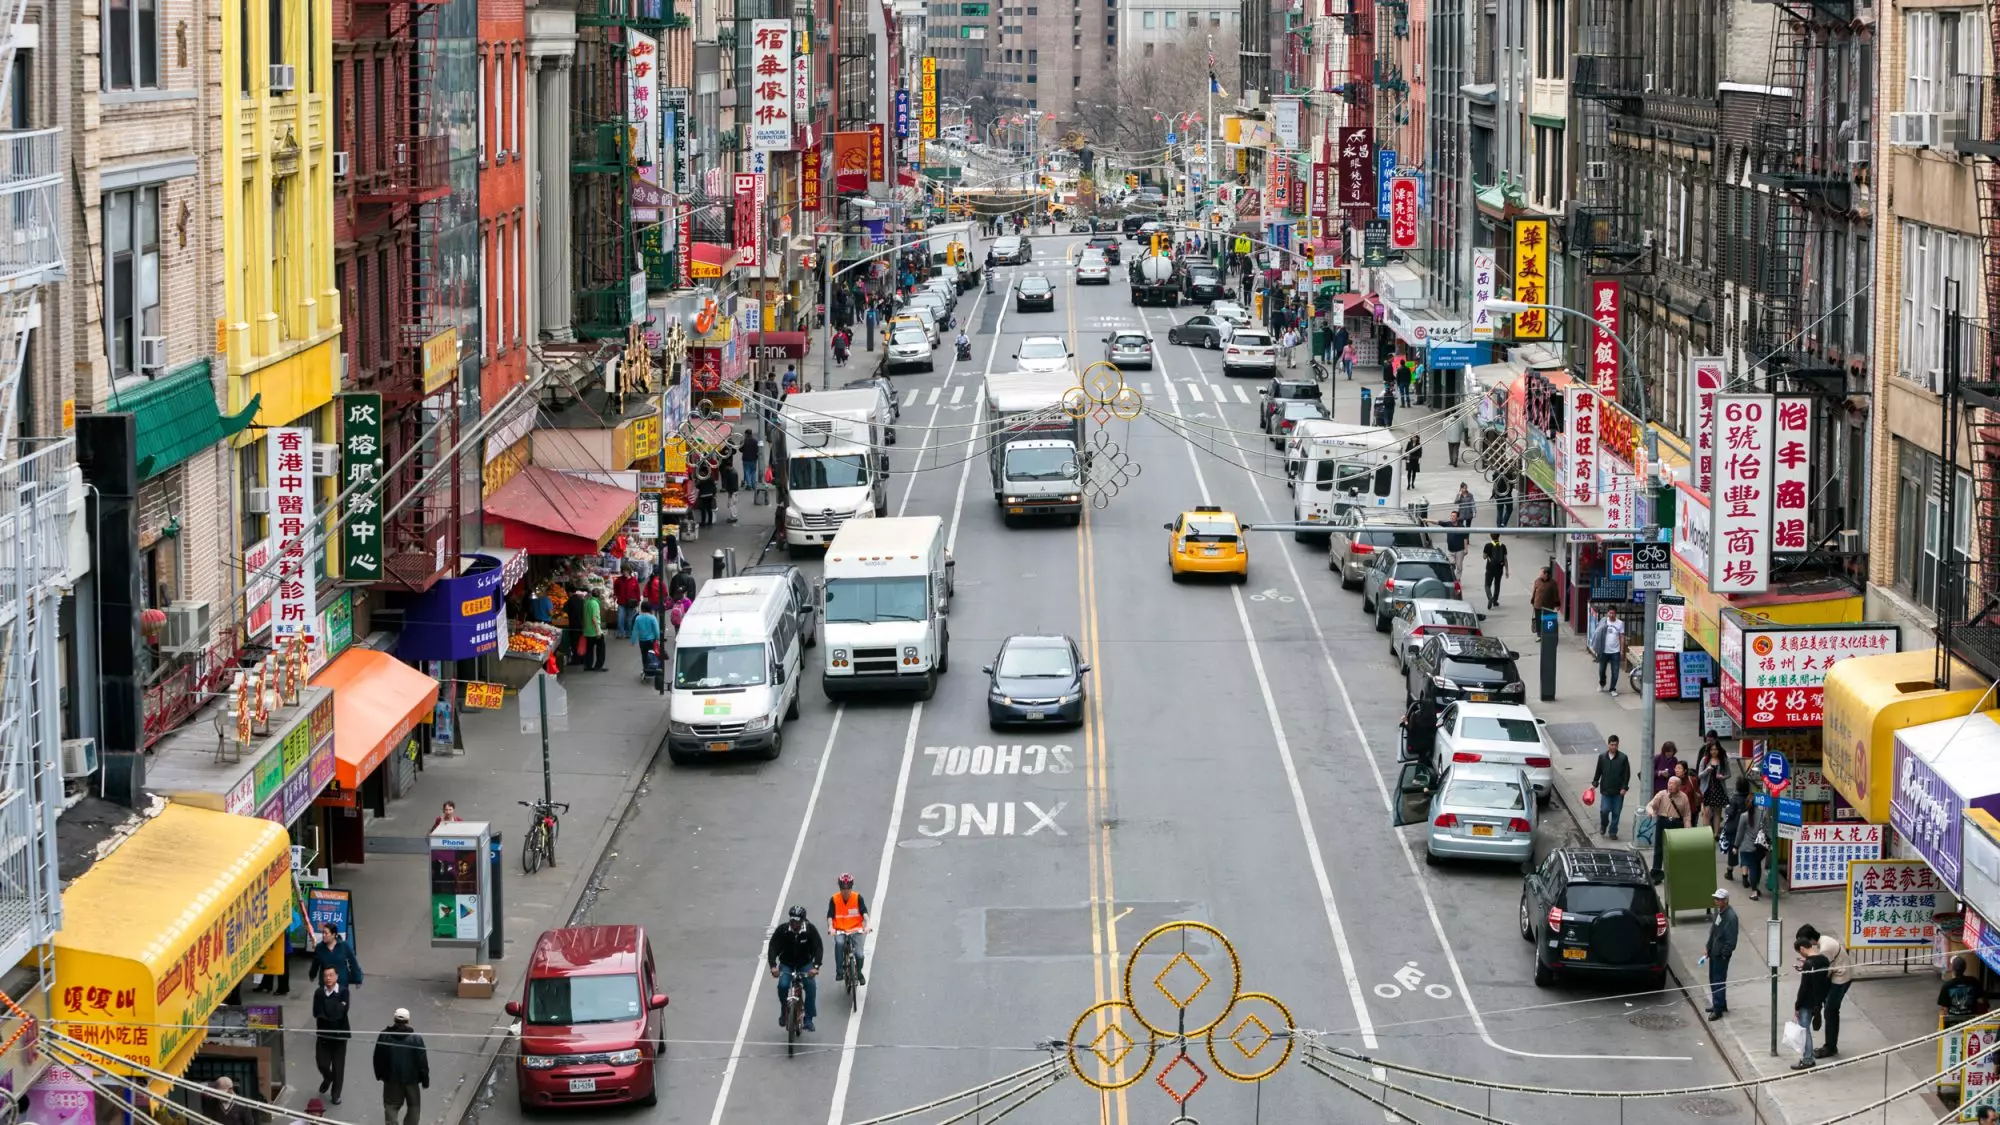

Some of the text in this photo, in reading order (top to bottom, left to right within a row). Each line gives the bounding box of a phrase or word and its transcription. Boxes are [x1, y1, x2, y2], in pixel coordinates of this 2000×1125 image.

[1343, 144, 1369, 158] 永昌
[837, 166, 868, 176] Library
[1519, 225, 1544, 335] 華美商場
[1595, 288, 1617, 393] 農家飯莊
[1573, 393, 1595, 503] 興旺旺商場
[277, 432, 306, 621] 香港中醫骨傷科診所
[1635, 562, 1649, 570] BIKE
[1786, 713, 1801, 721] TEL
[1802, 713, 1809, 721] &
[924, 744, 1075, 796] SCHOOL
[917, 801, 1070, 837] XING
[1863, 925, 1934, 938] 郵寄全中國
[67, 1024, 149, 1046] 福州小吃店
